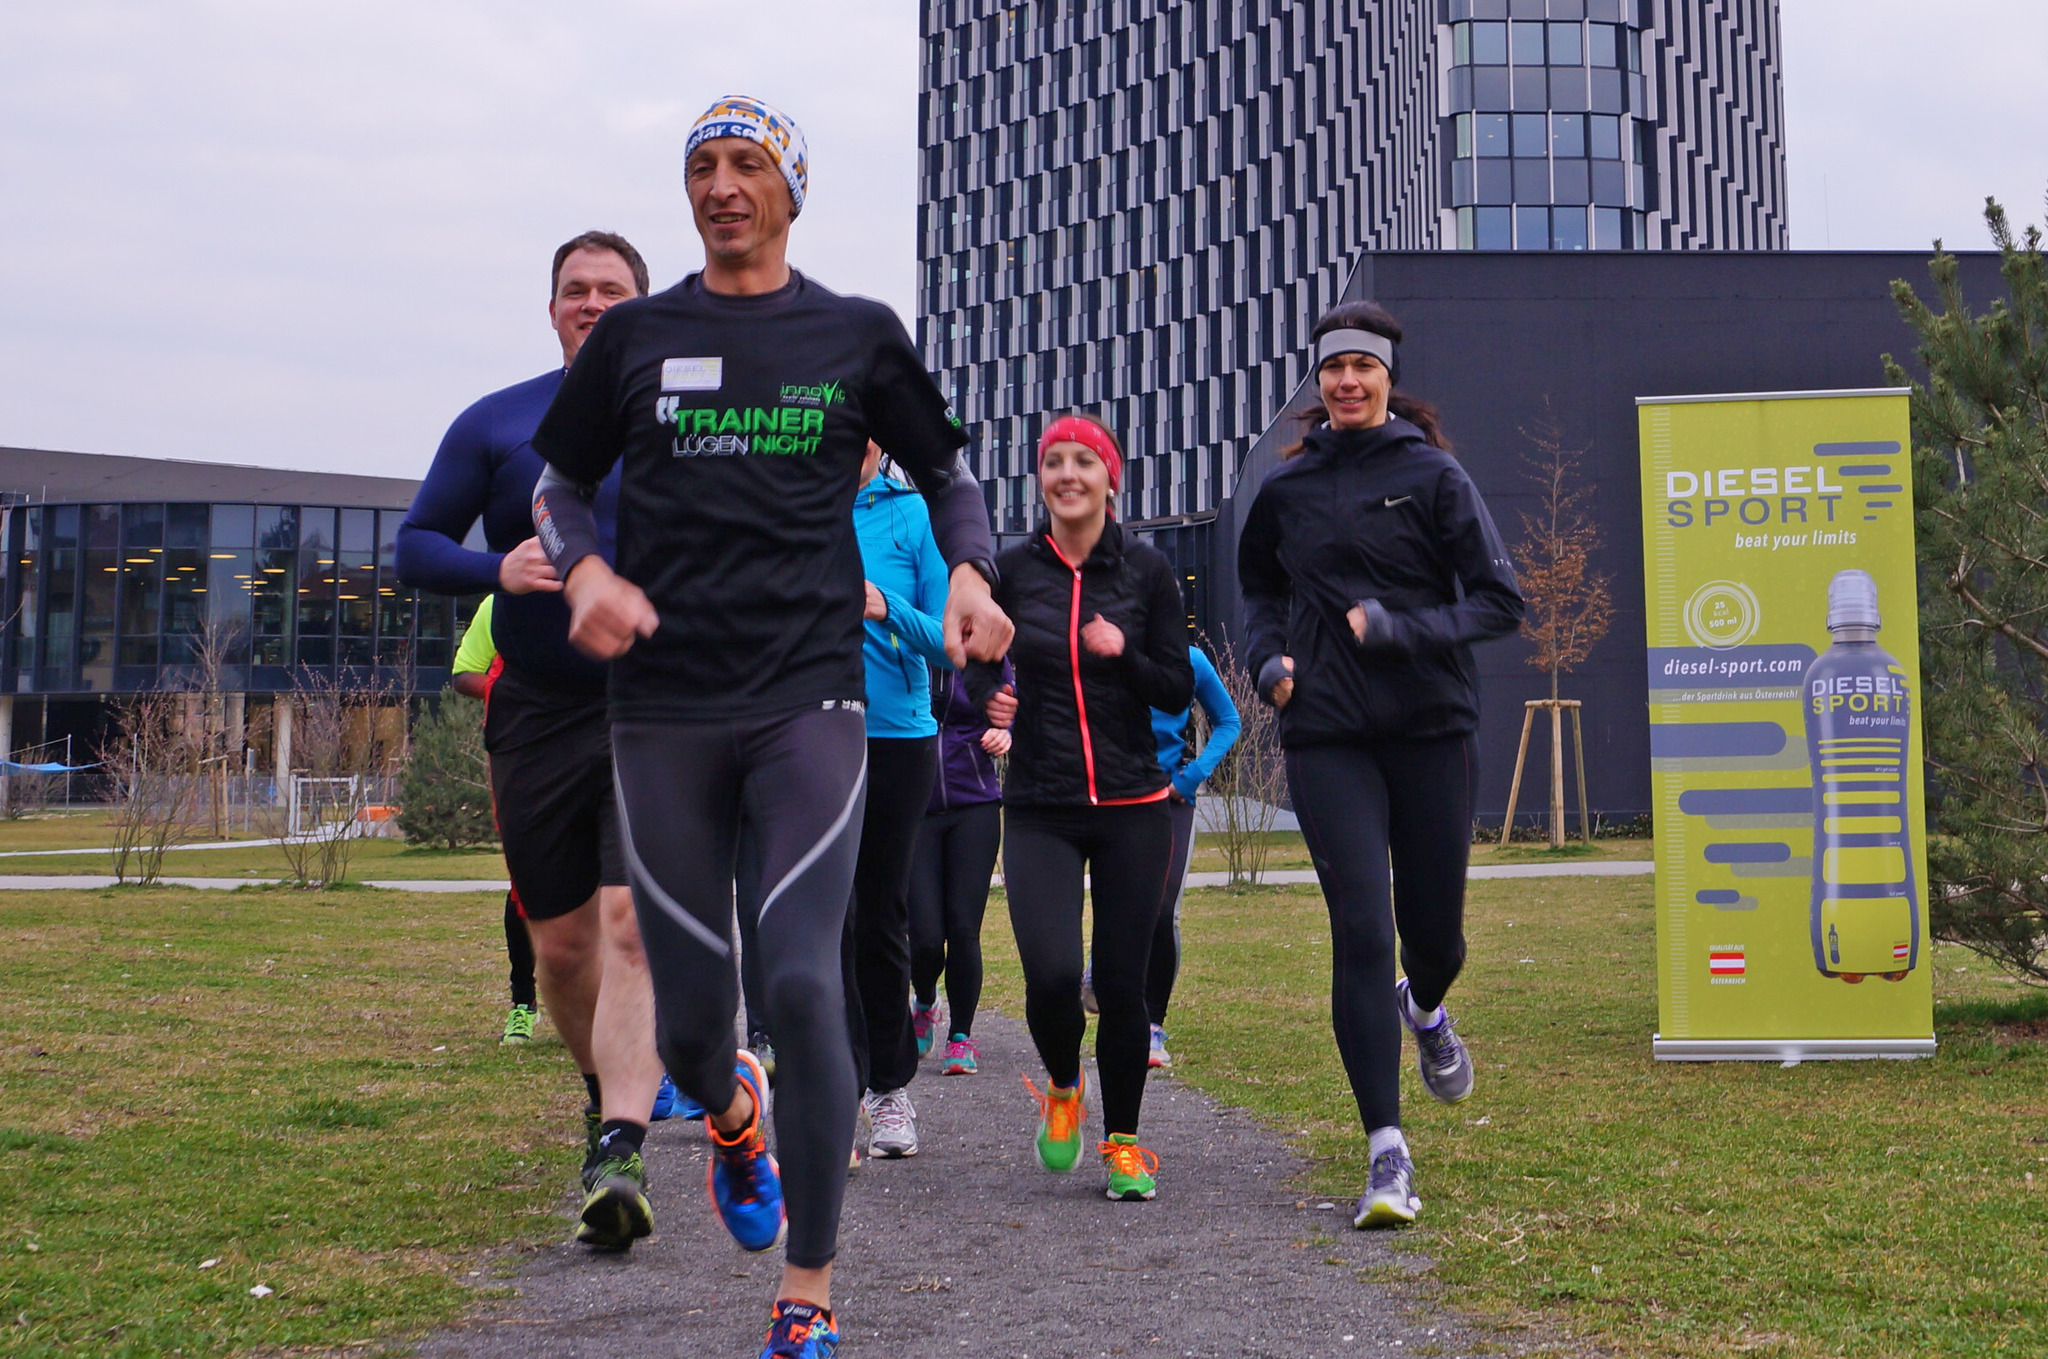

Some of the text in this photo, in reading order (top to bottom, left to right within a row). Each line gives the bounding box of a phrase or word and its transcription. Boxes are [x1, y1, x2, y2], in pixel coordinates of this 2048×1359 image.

[672, 434, 822, 457] LÜGEN NICHT
[1666, 466, 1843, 498] DIESEL
[1667, 495, 1843, 528] SPORT
[1734, 530, 1857, 551] beat your limits
[1709, 619, 1725, 628] 500
[1664, 658, 1802, 678] diesel-sport.com
[1696, 690, 1738, 703] Sportdrink
[1739, 692, 1752, 700] aus
[1812, 676, 1903, 697] DIESEL
[1812, 693, 1903, 715] SPORT
[1849, 715, 1869, 726] beat
[1870, 717, 1889, 728] your
